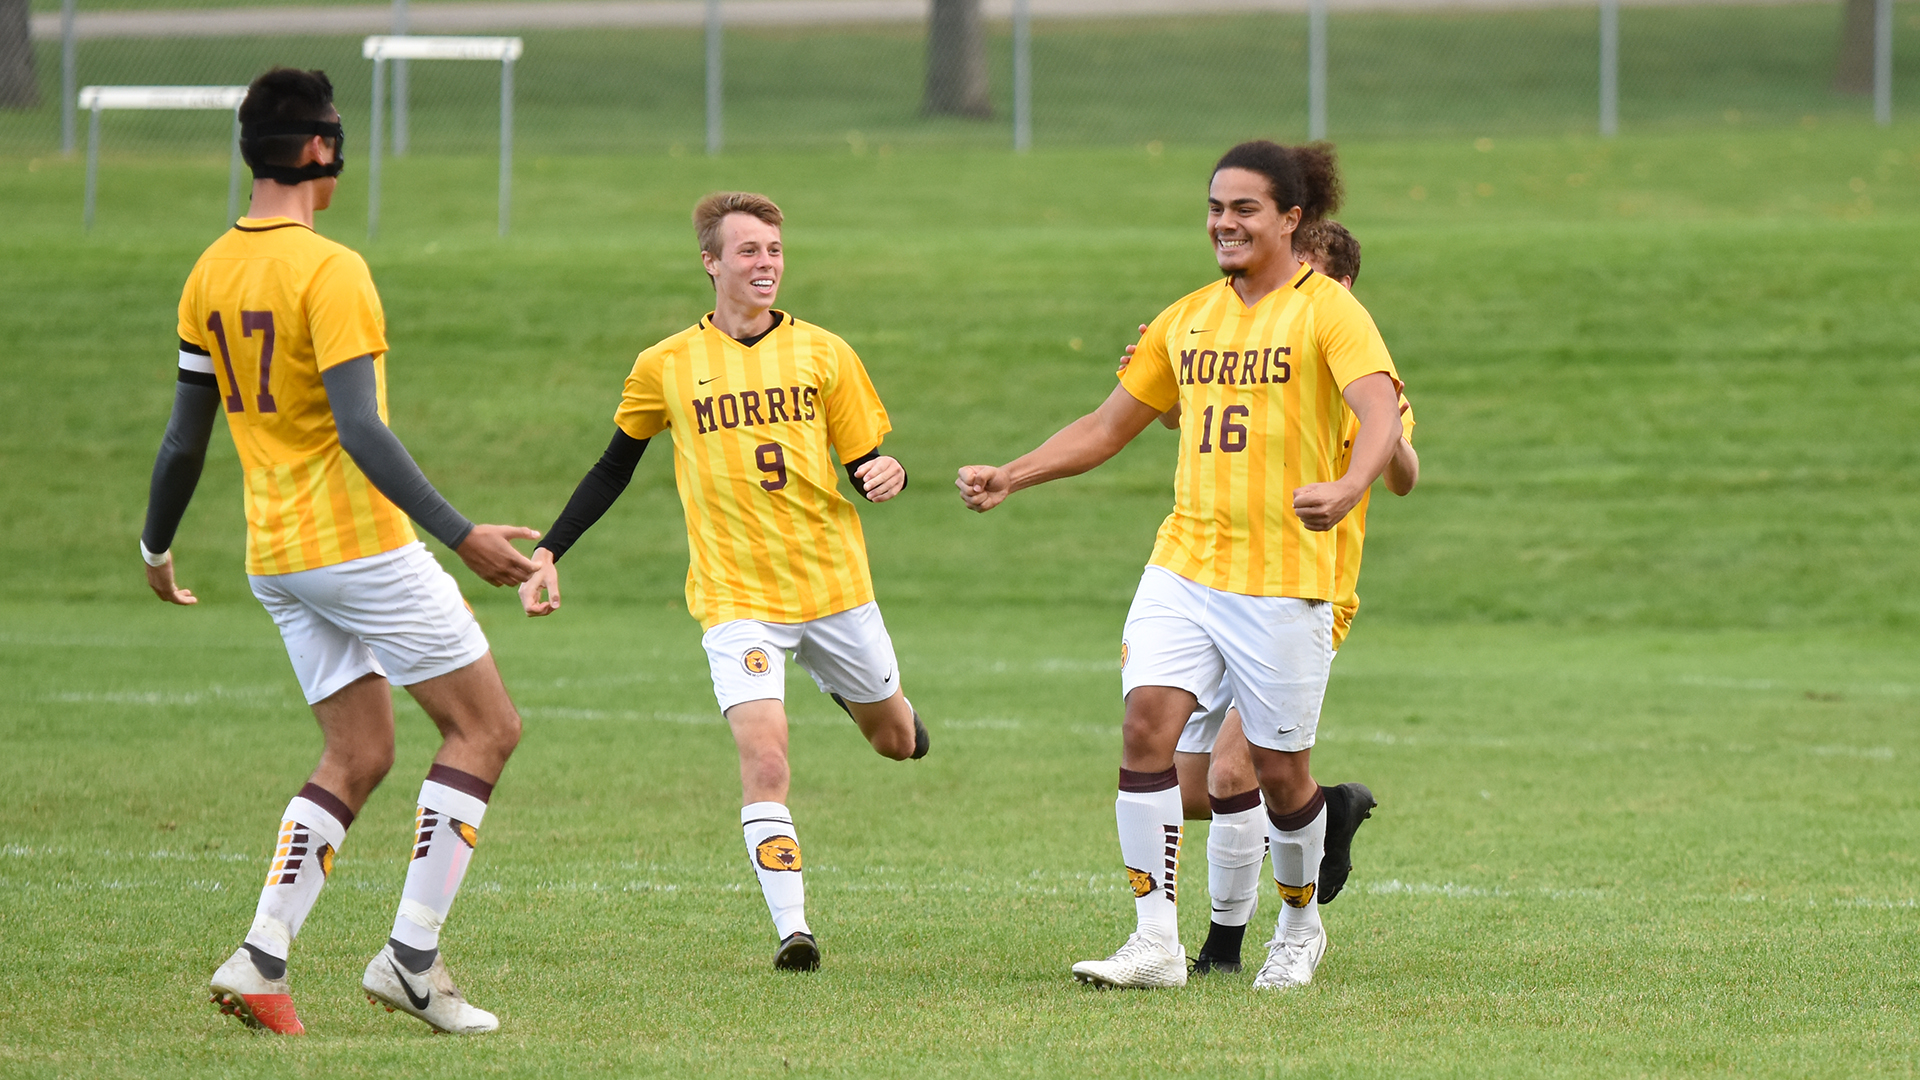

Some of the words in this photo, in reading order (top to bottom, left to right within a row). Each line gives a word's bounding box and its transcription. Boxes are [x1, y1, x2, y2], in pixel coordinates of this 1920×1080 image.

[206, 310, 277, 413] 17
[1179, 346, 1291, 386] MORRIS
[692, 386, 818, 434] MORRIS
[1199, 404, 1249, 454] 16
[755, 441, 788, 492] 9
